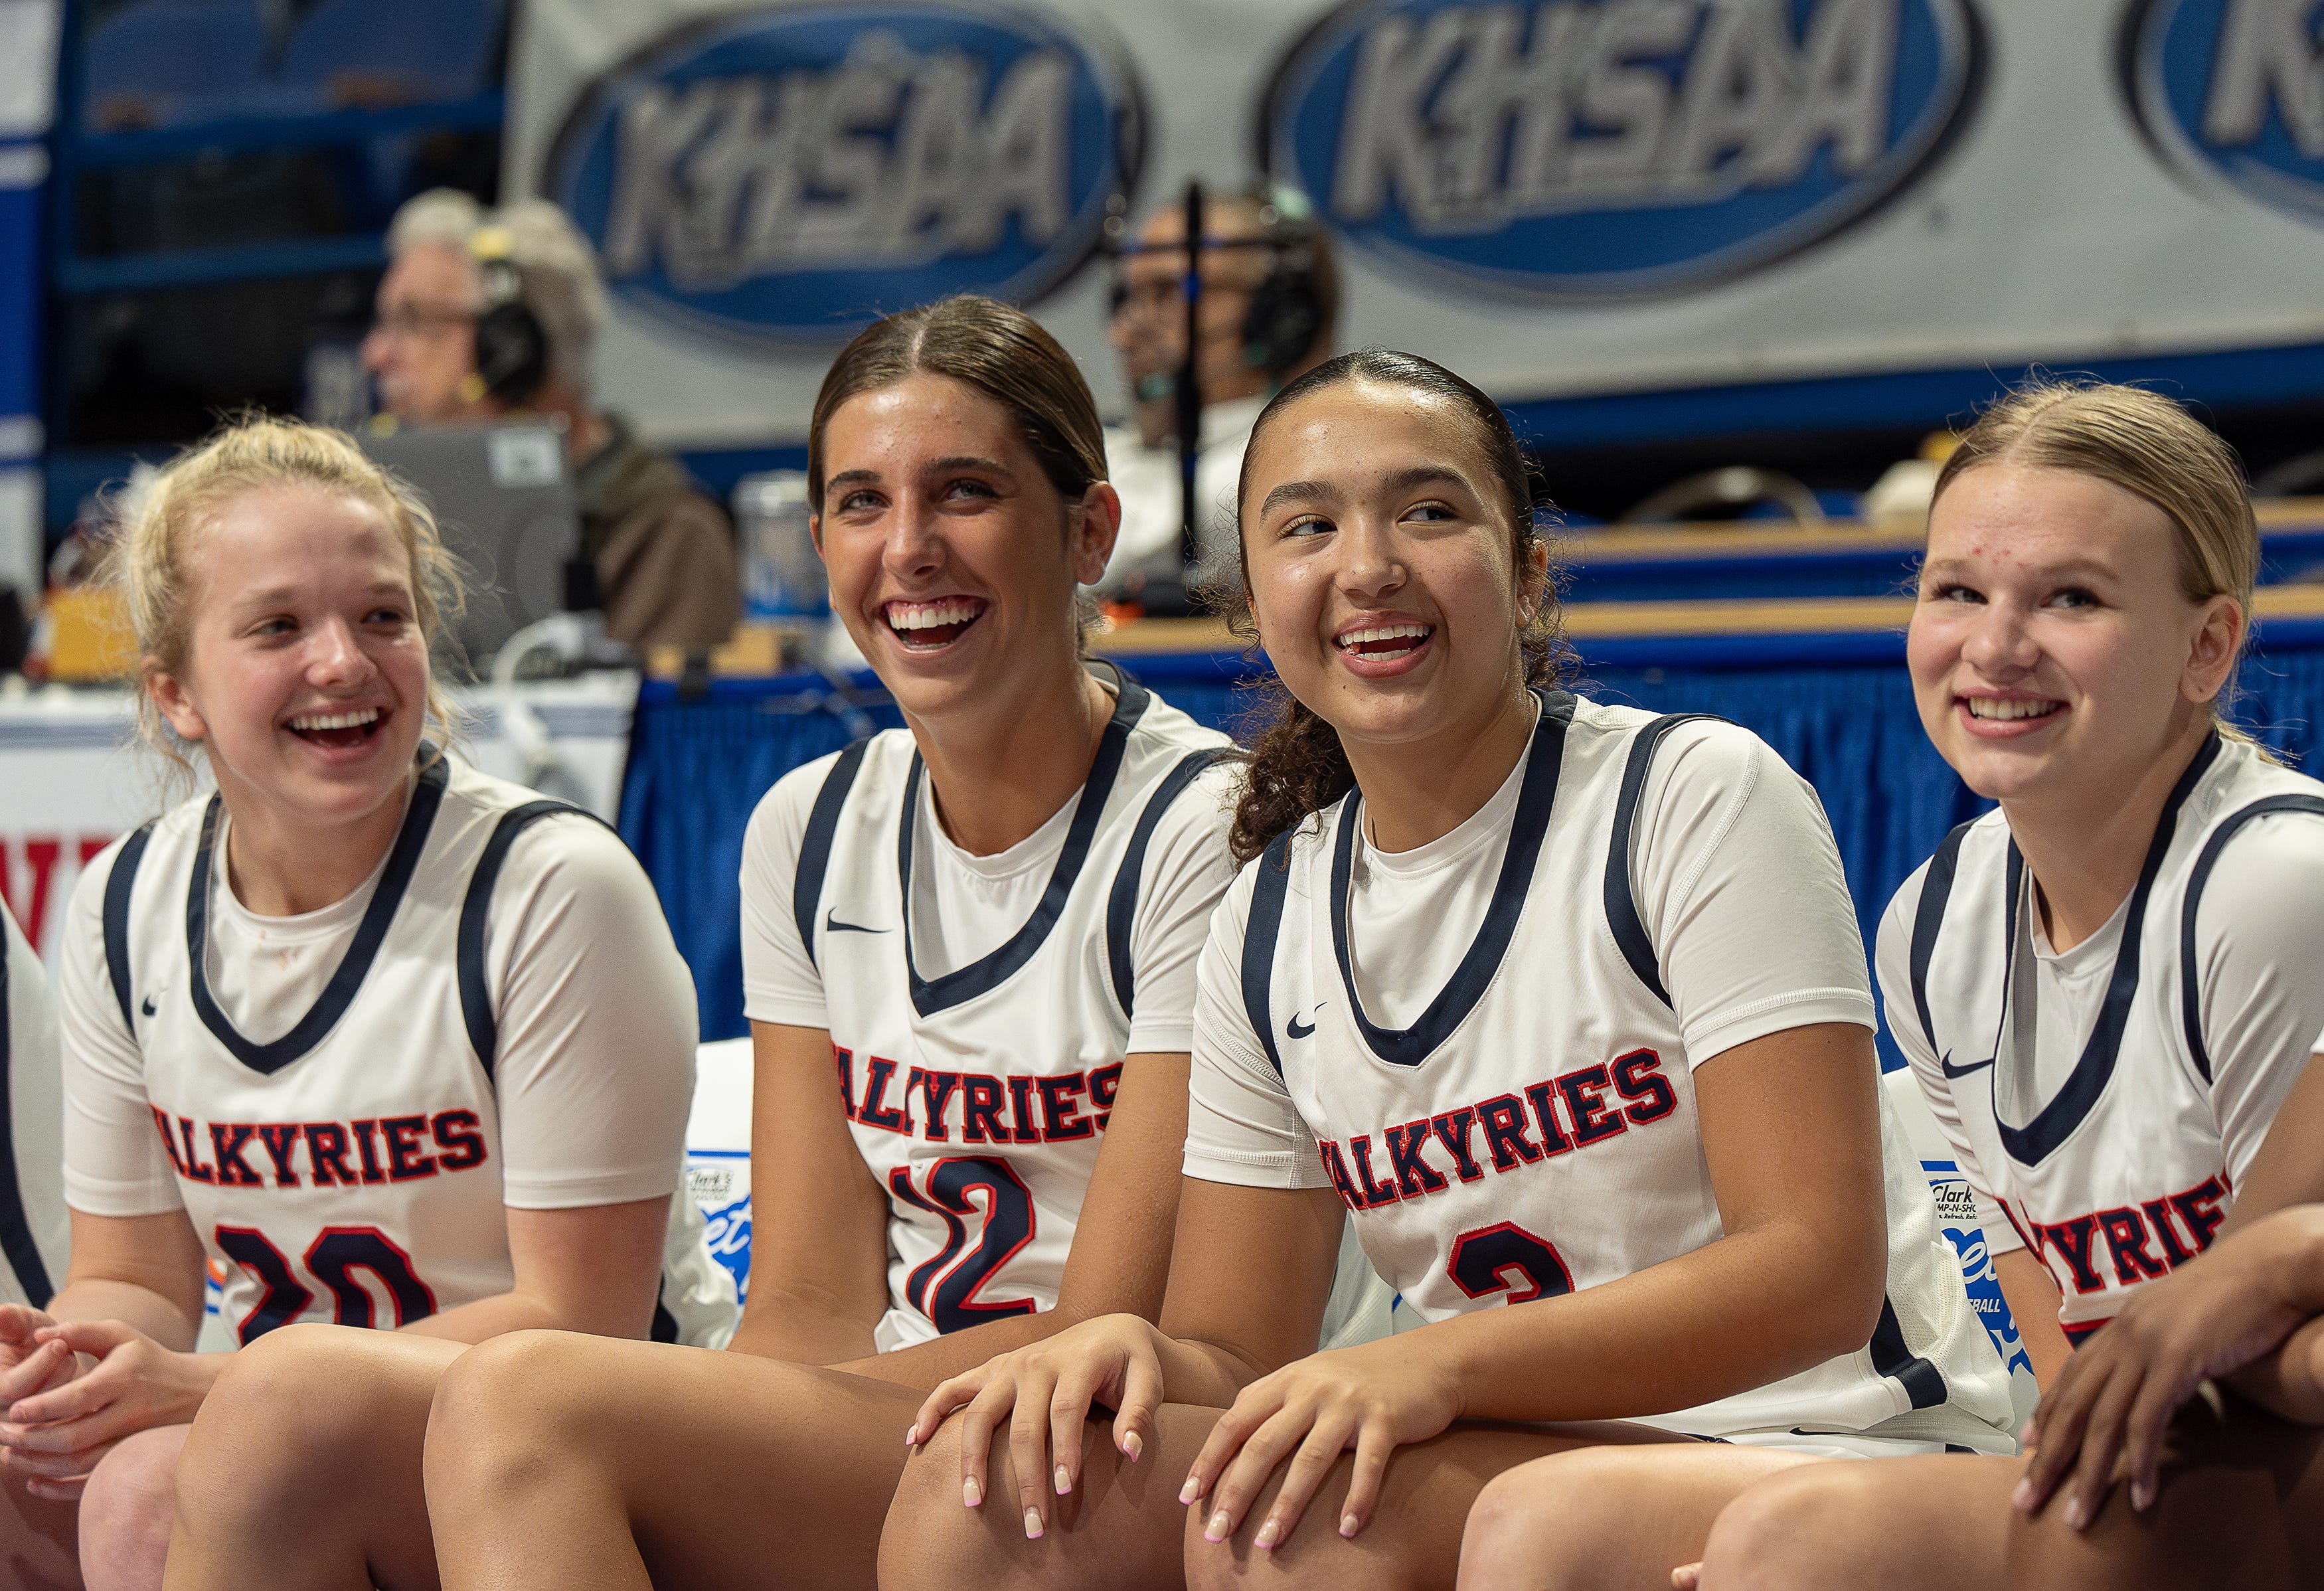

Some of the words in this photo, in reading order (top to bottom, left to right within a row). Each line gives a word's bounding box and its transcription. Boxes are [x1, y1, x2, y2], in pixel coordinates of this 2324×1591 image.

[603, 43, 1072, 282] KHSAA
[1333, 0, 1896, 227] KHSAA
[149, 1102, 488, 1187] ALKYRIES
